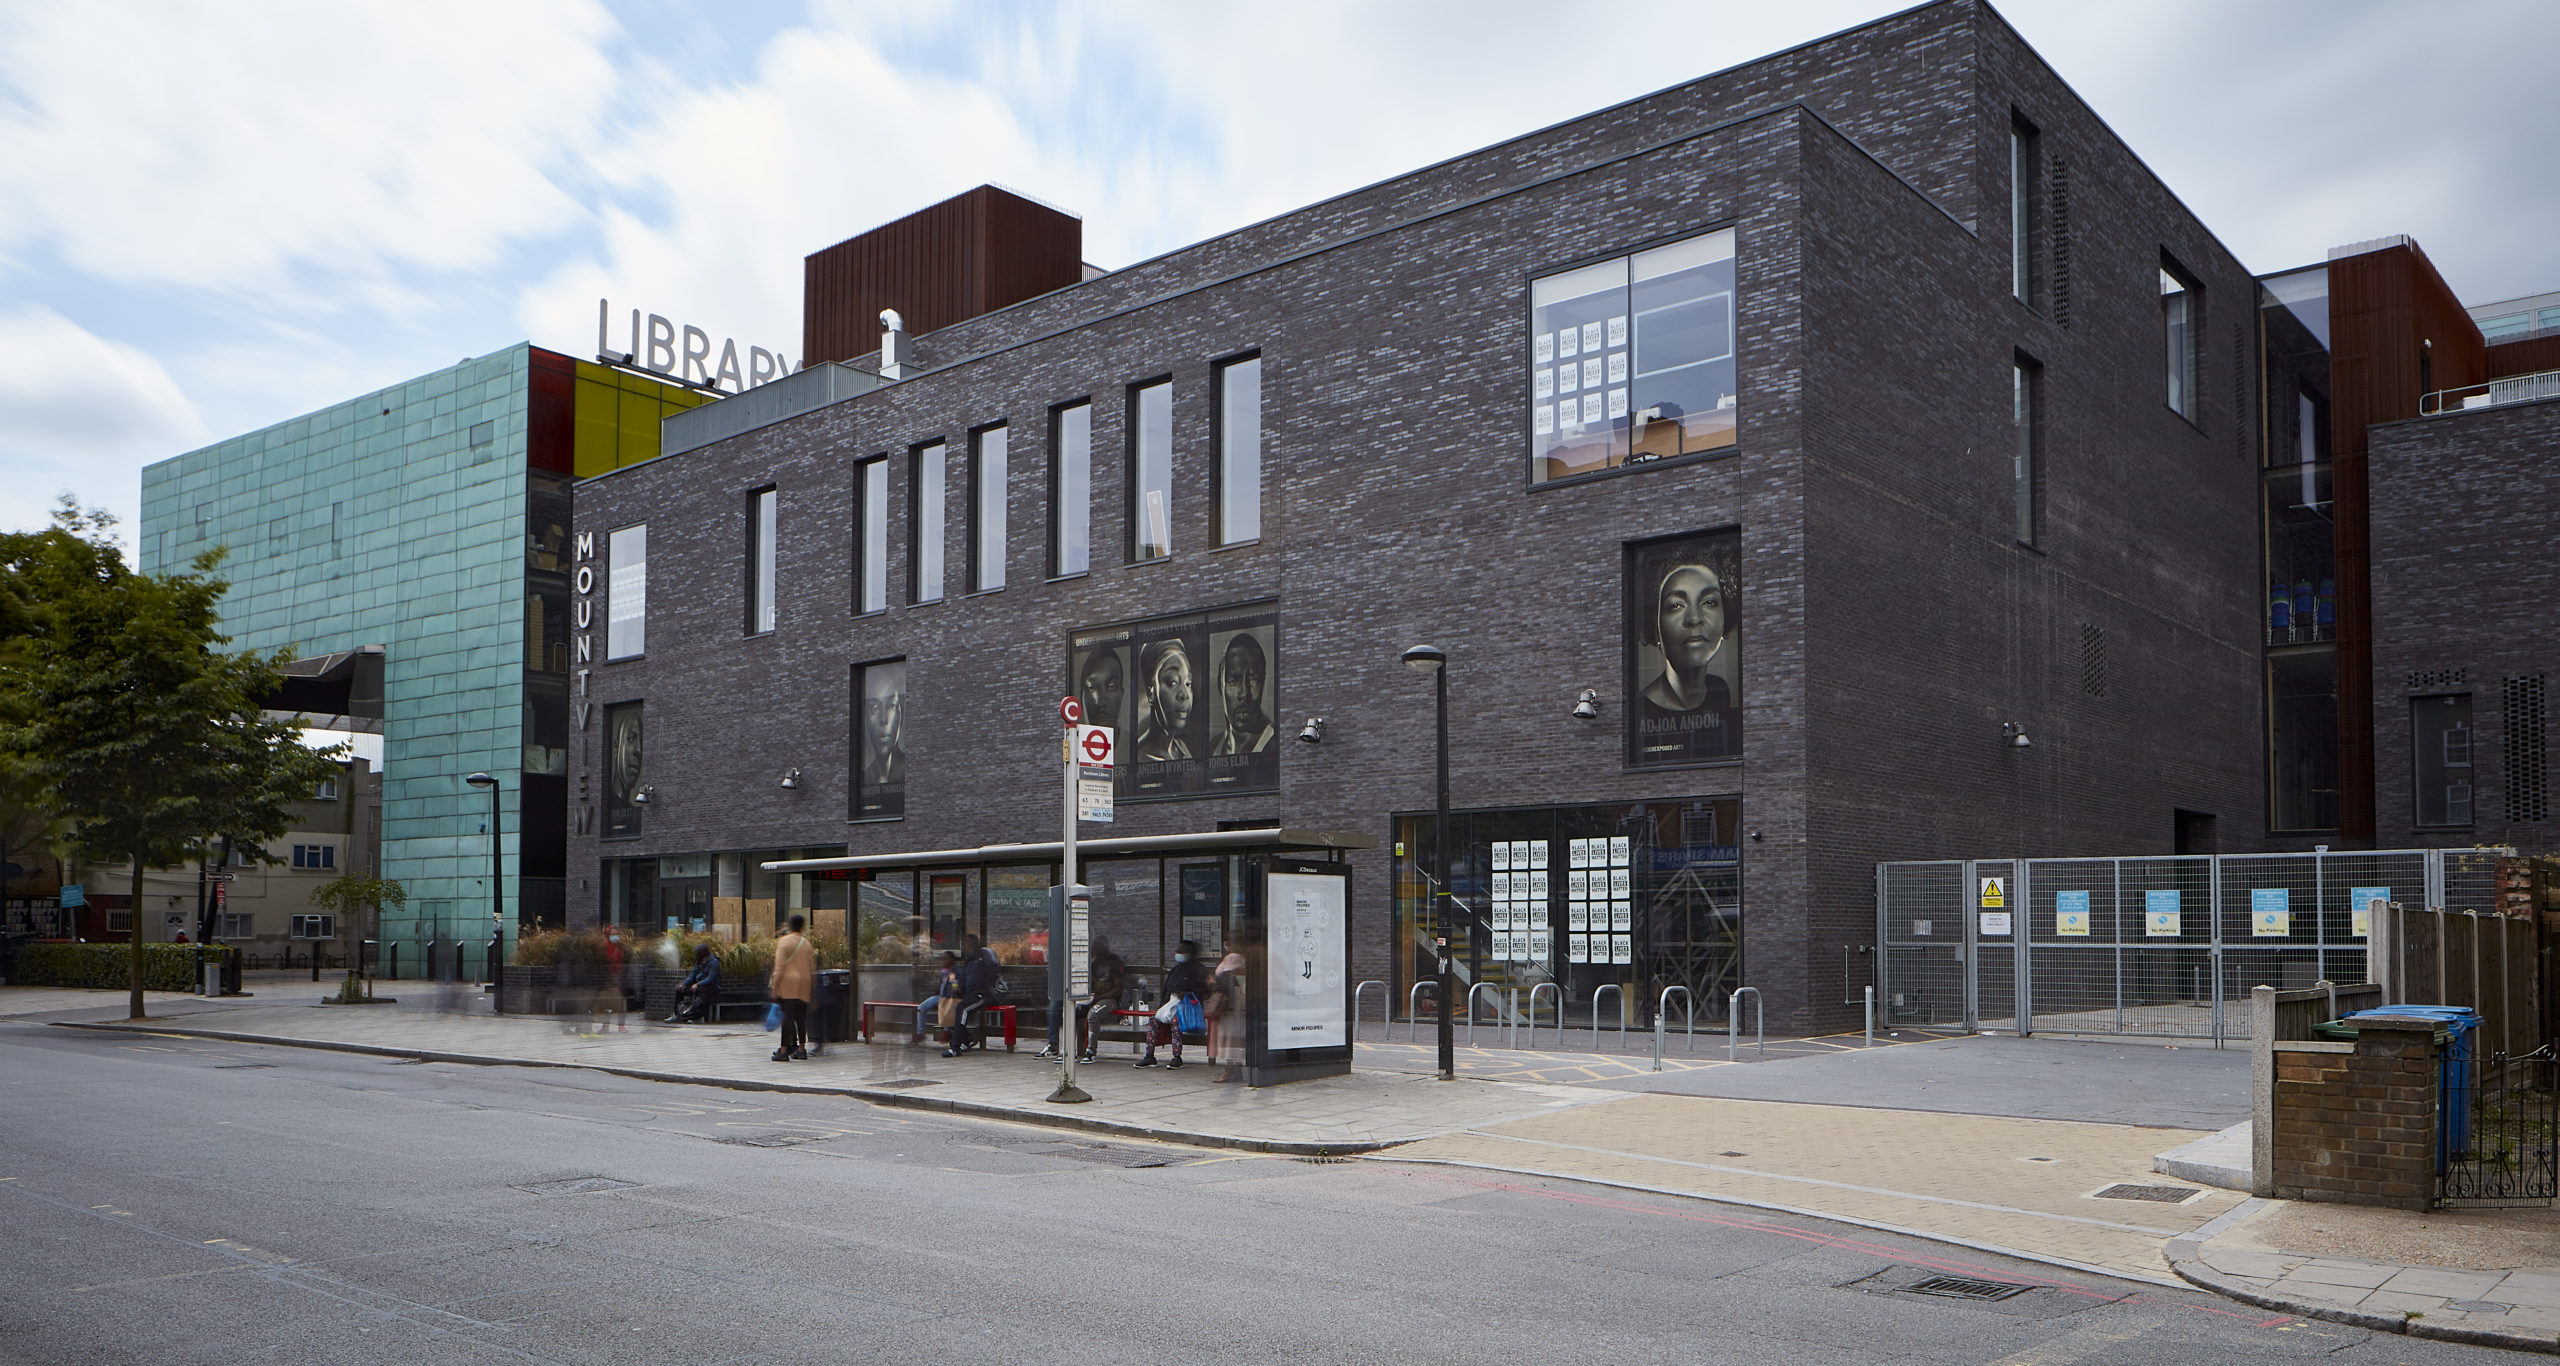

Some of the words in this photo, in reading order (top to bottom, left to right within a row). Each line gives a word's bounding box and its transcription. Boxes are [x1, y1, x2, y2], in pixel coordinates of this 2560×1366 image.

[598, 298, 803, 393] LIBRARY
[1143, 620, 1197, 638] MOUNTVIEW
[573, 531, 595, 834] MOUNTVIEW
[1064, 701, 1078, 720] C
[1640, 717, 1677, 734] ADJOA
[1680, 712, 1719, 731] ANDOH
[1138, 762, 1165, 776] ANGELA
[1165, 759, 1196, 773] WYNTER
[1208, 756, 1229, 769] IDRIS
[1230, 754, 1249, 767] ELBA
